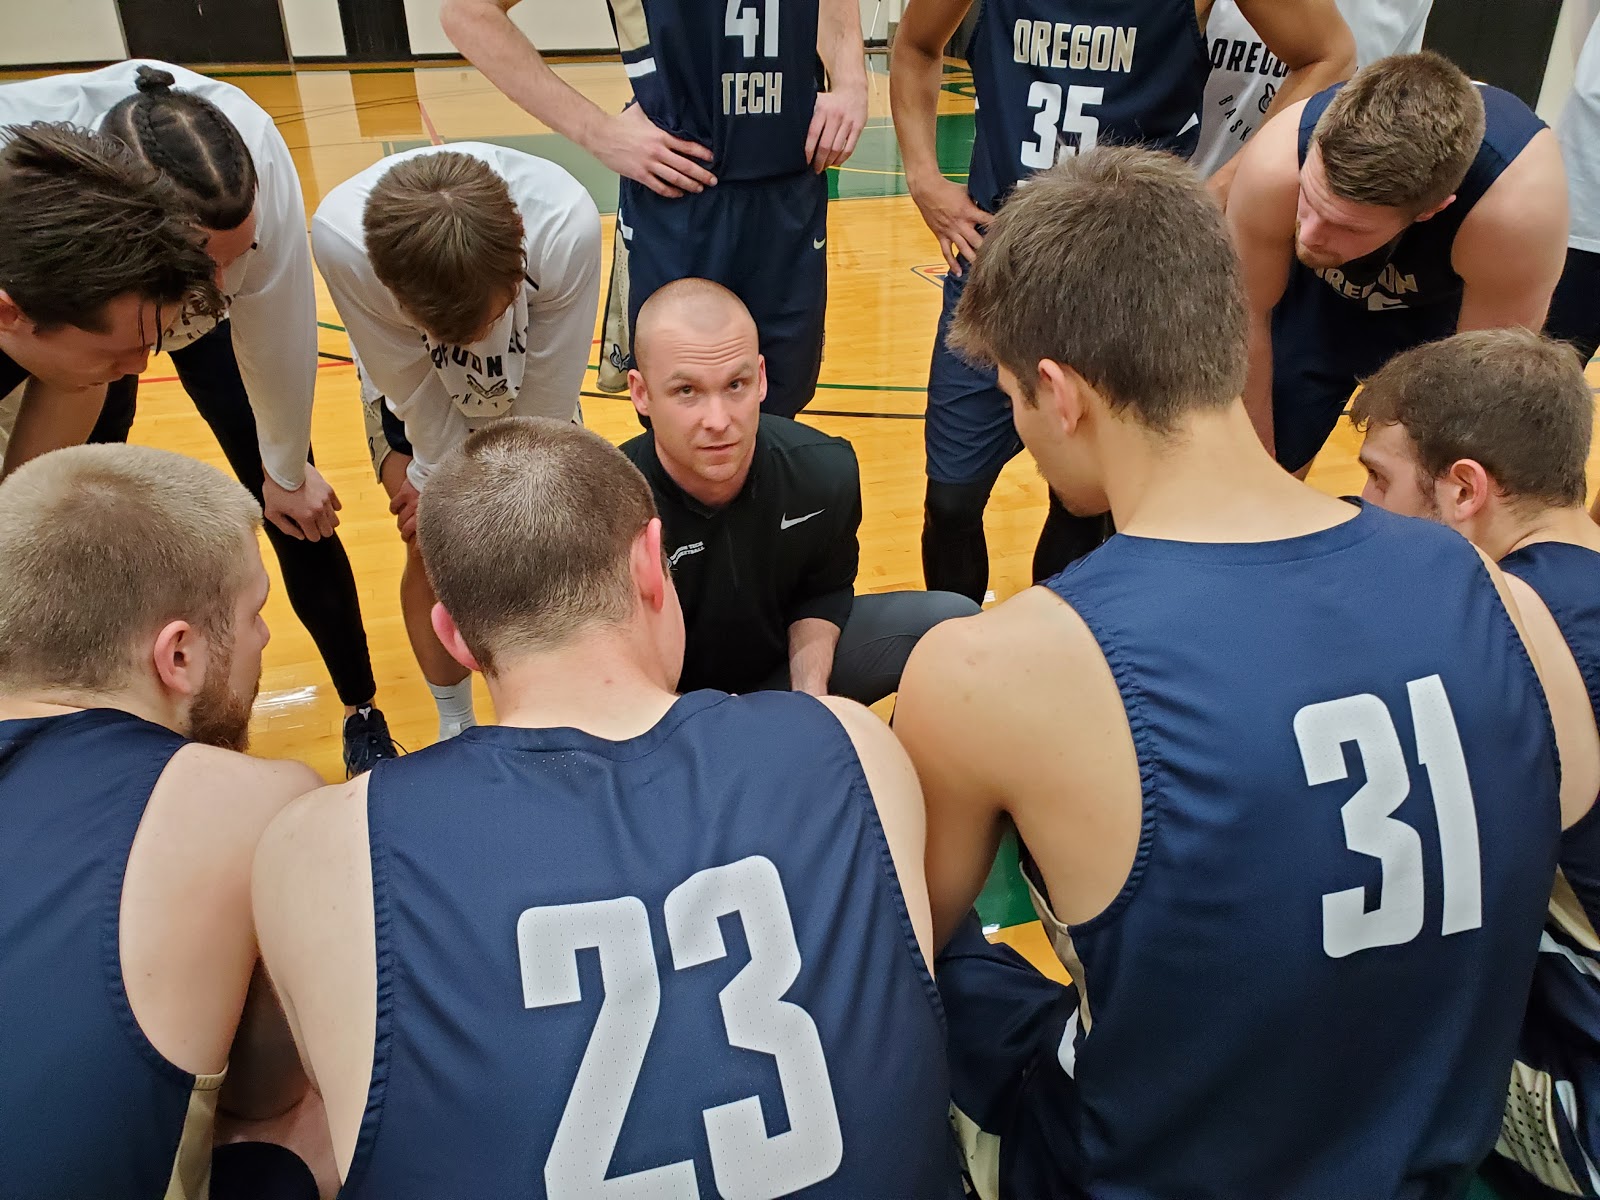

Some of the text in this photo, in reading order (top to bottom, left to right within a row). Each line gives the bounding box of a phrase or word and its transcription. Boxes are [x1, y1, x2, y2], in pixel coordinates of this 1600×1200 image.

[724, 0, 779, 57] 41
[1013, 19, 1137, 73] OREGON
[1210, 38, 1290, 78] OREGO
[721, 72, 783, 115] TECH
[1020, 81, 1104, 169] 35
[1314, 263, 1419, 299] REON
[1293, 673, 1482, 958] 31
[517, 855, 843, 1200] 23
